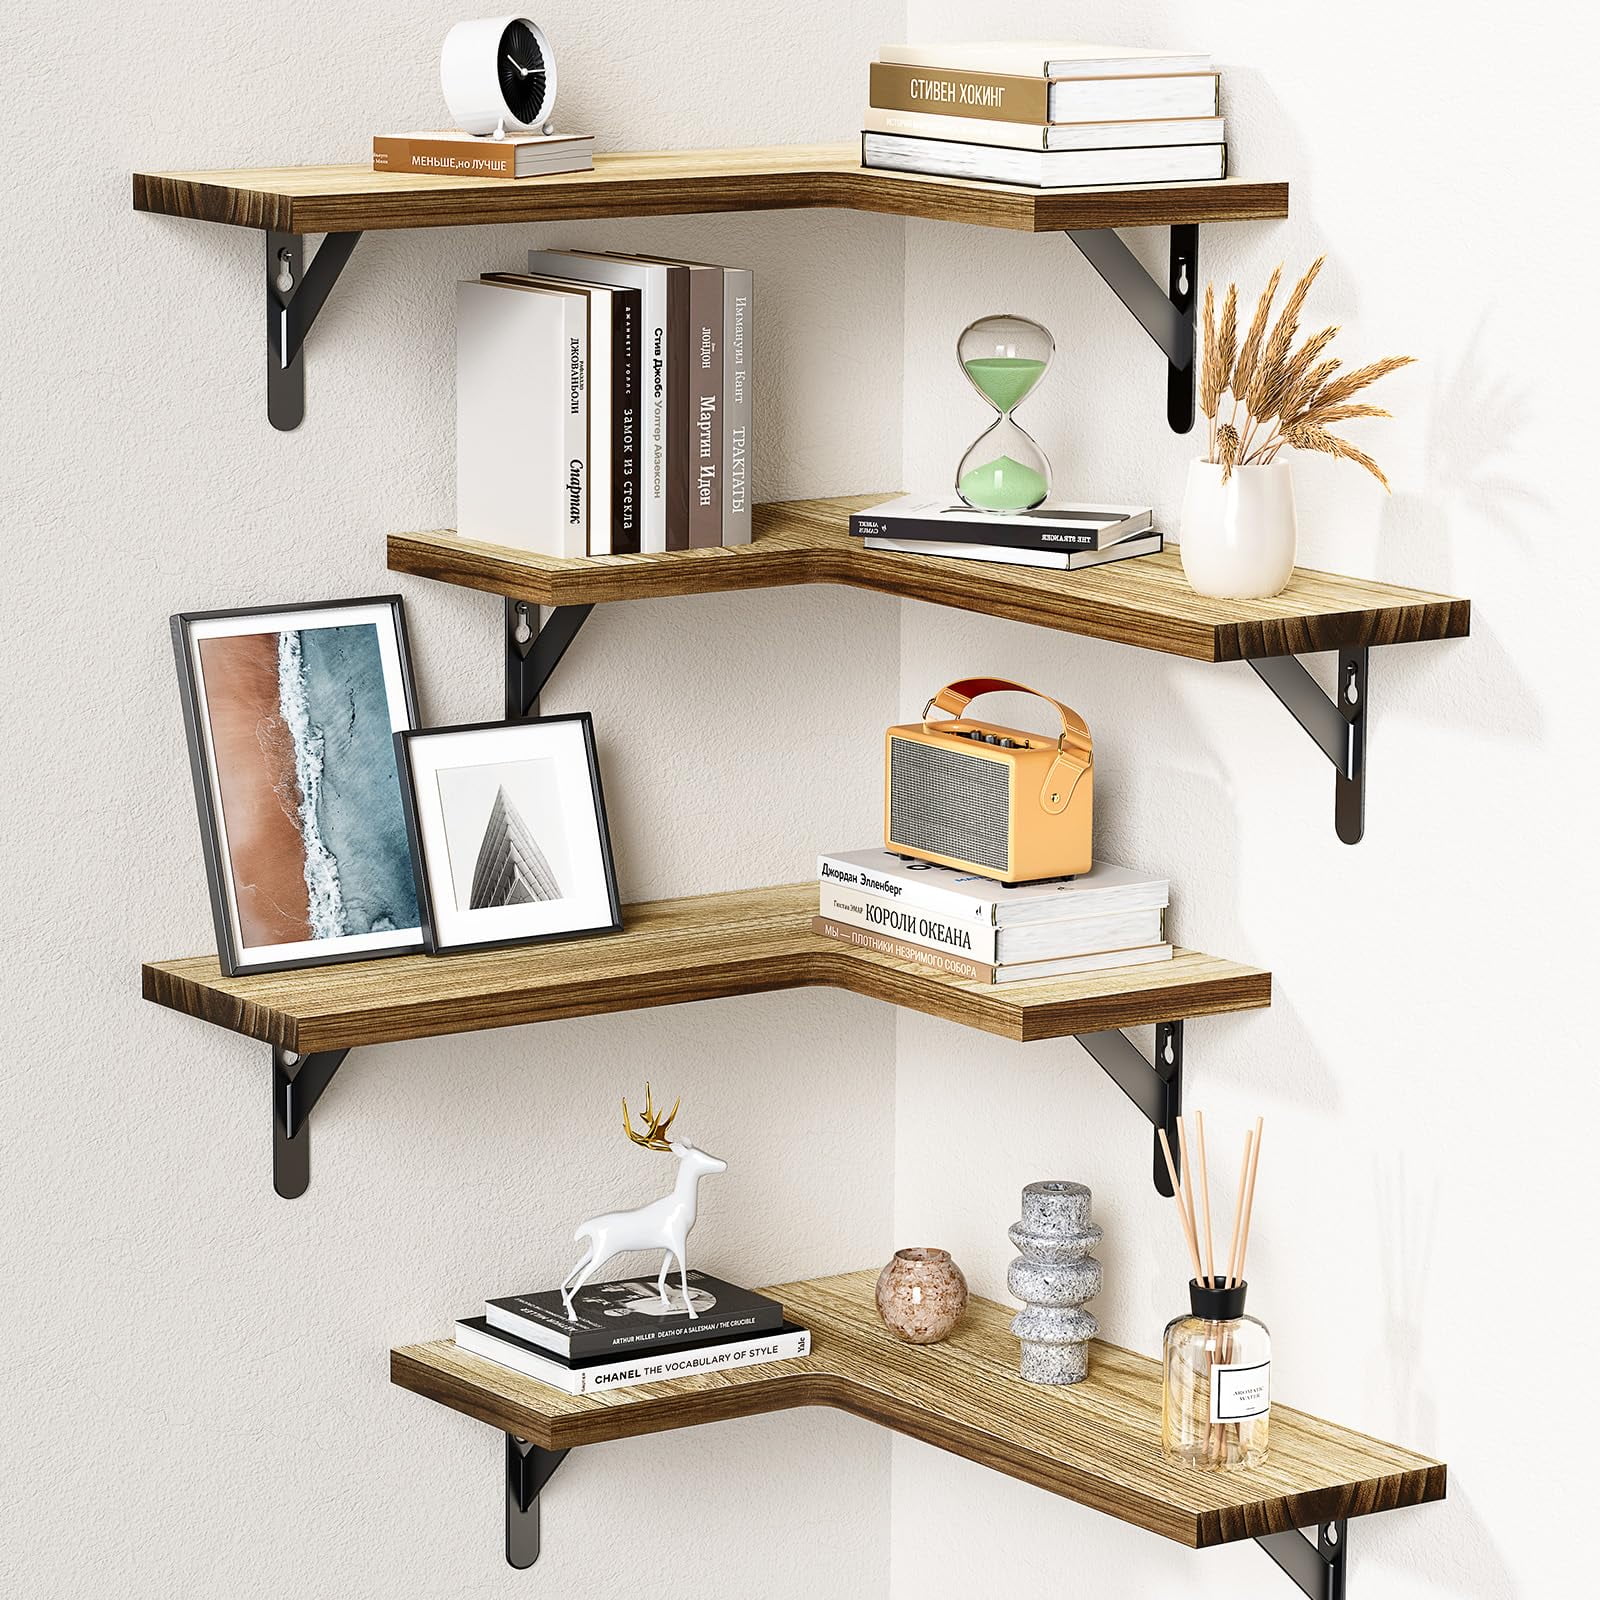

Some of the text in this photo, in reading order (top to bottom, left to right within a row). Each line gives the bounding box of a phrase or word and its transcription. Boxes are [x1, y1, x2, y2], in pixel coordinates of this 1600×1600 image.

[910, 79, 1005, 107] СТИВЕН ХОКИНГ
[472, 160, 507, 170] ЛУЧШЕ
[570, 338, 579, 414] ДЖОВАНЬОЛИ
[653, 328, 663, 498] Стив Джобс Уолтер Айзексон
[697, 396, 716, 458] Мартин
[732, 297, 747, 513] Иммануил Кант ТРАКТАТЫ
[624, 408, 632, 452] замок
[624, 458, 632, 475] из
[698, 465, 716, 506] Иден
[566, 459, 584, 524] Спартак
[624, 482, 632, 529] стекла
[822, 862, 902, 896] Джордан Элленберг
[866, 904, 916, 934] КОРОЛИ
[920, 919, 972, 950] ОКЕАНА
[824, 924, 838, 937] МЫ
[852, 932, 894, 953] ПЛОТНИКИ
[896, 944, 944, 970] НЕЗРИМОГО
[944, 960, 977, 978] СОБОРА
[612, 1336, 634, 1345] ARTHUR
[635, 1333, 656, 1342] MILLER
[658, 1330, 675, 1338] DEATH
[688, 1324, 715, 1334] SALESMAN
[730, 1318, 756, 1328] CRUCIBLE
[798, 1336, 806, 1352] Yale
[594, 1345, 778, 1384] CHANEL THE VOCABULARY OF STYLE
